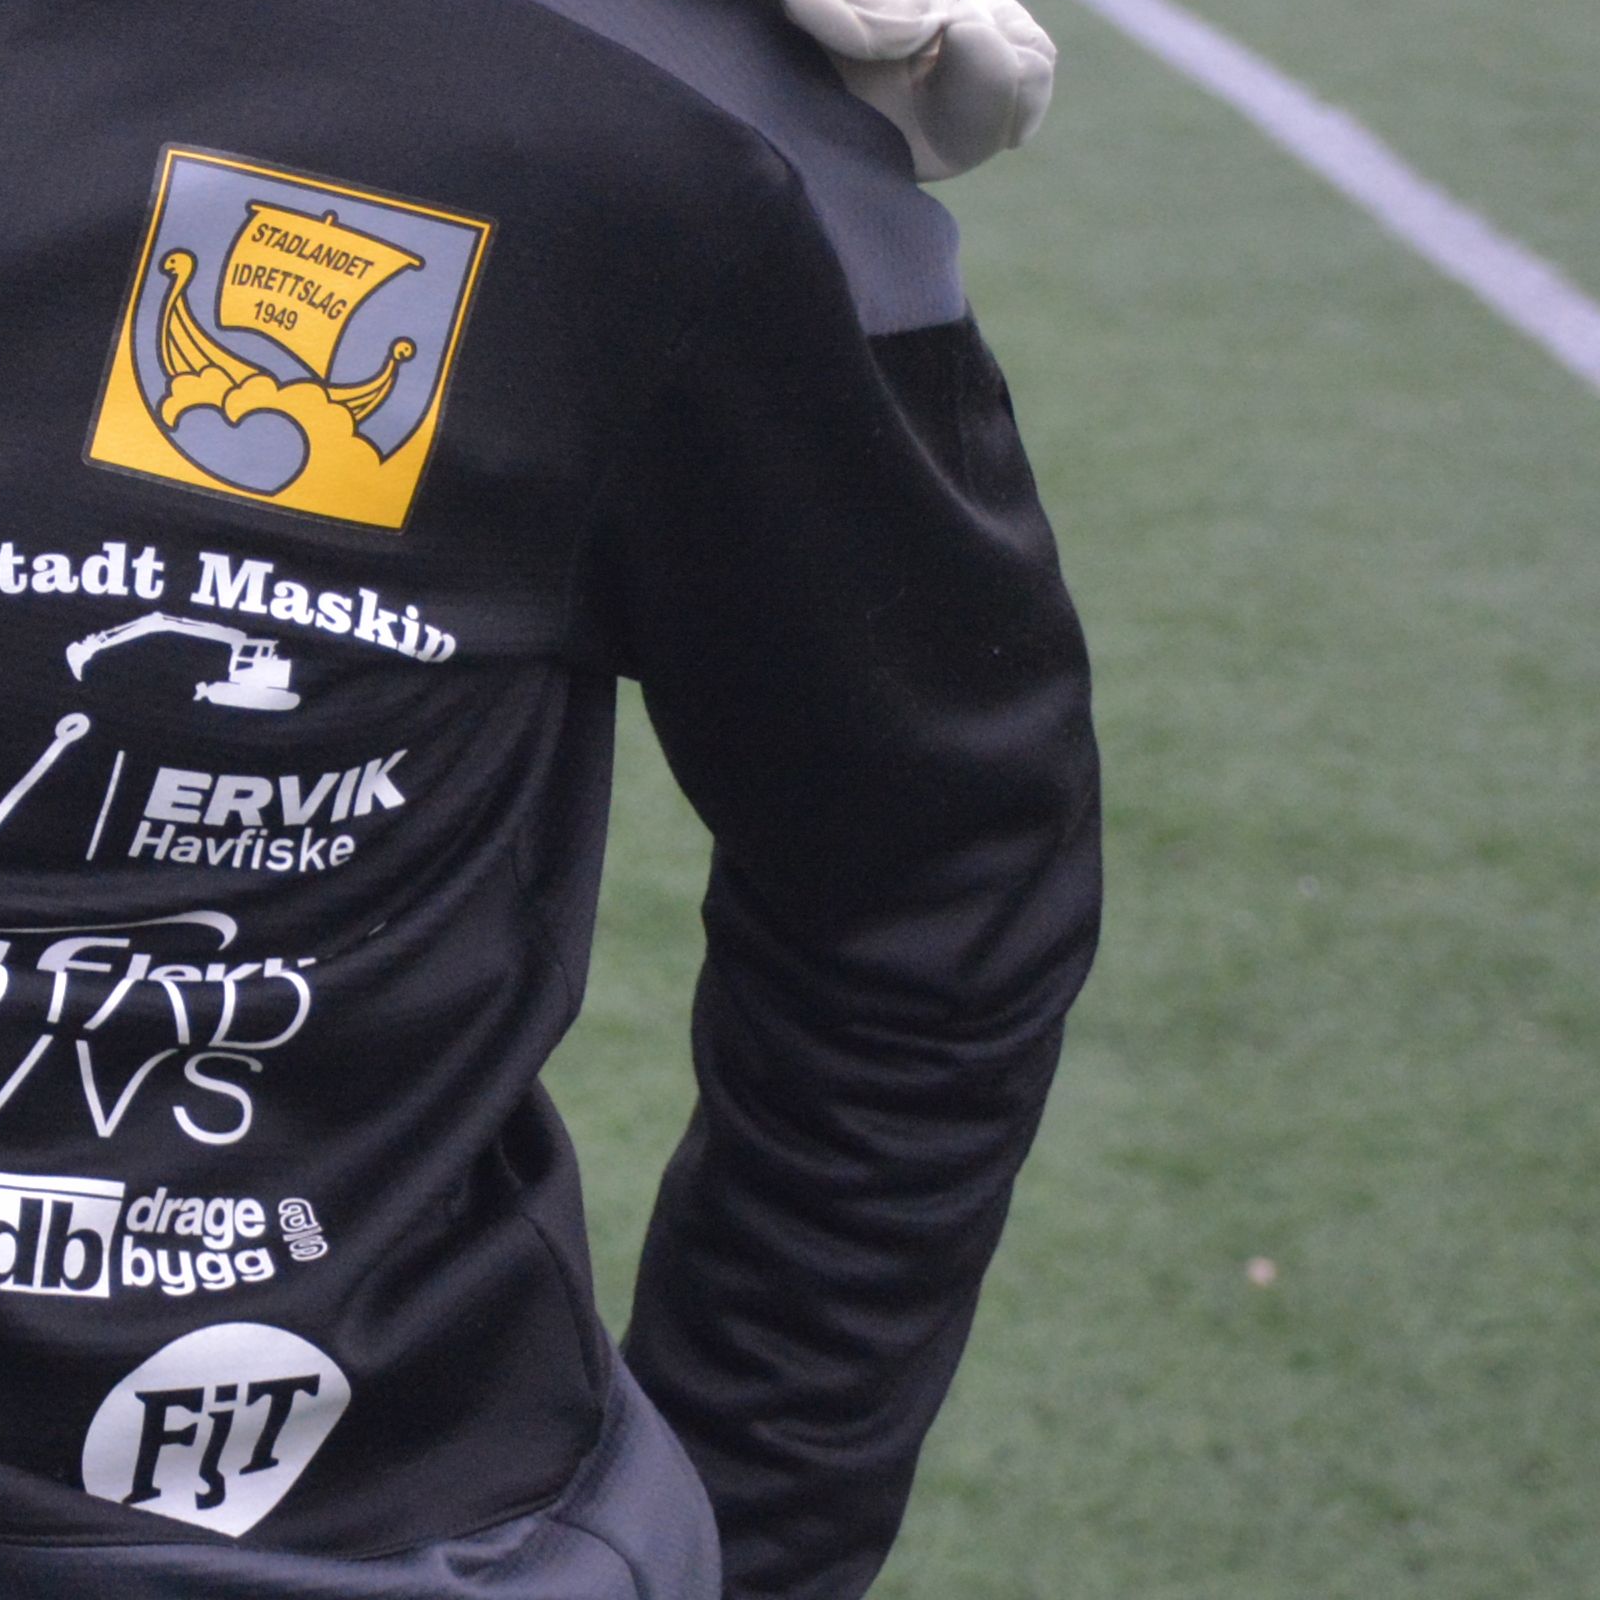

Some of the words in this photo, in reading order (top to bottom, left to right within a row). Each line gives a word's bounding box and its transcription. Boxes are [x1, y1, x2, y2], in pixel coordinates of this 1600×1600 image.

[251, 223, 375, 280] STADLANDET
[231, 263, 347, 321] IDRETTSLAG
[253, 300, 298, 330] 1949
[189, 552, 457, 664] Maskin
[144, 749, 408, 828] ERVIK
[128, 821, 355, 873] Havfiske
[126, 1188, 266, 1251] drage
[122, 1236, 275, 1297] bygg
